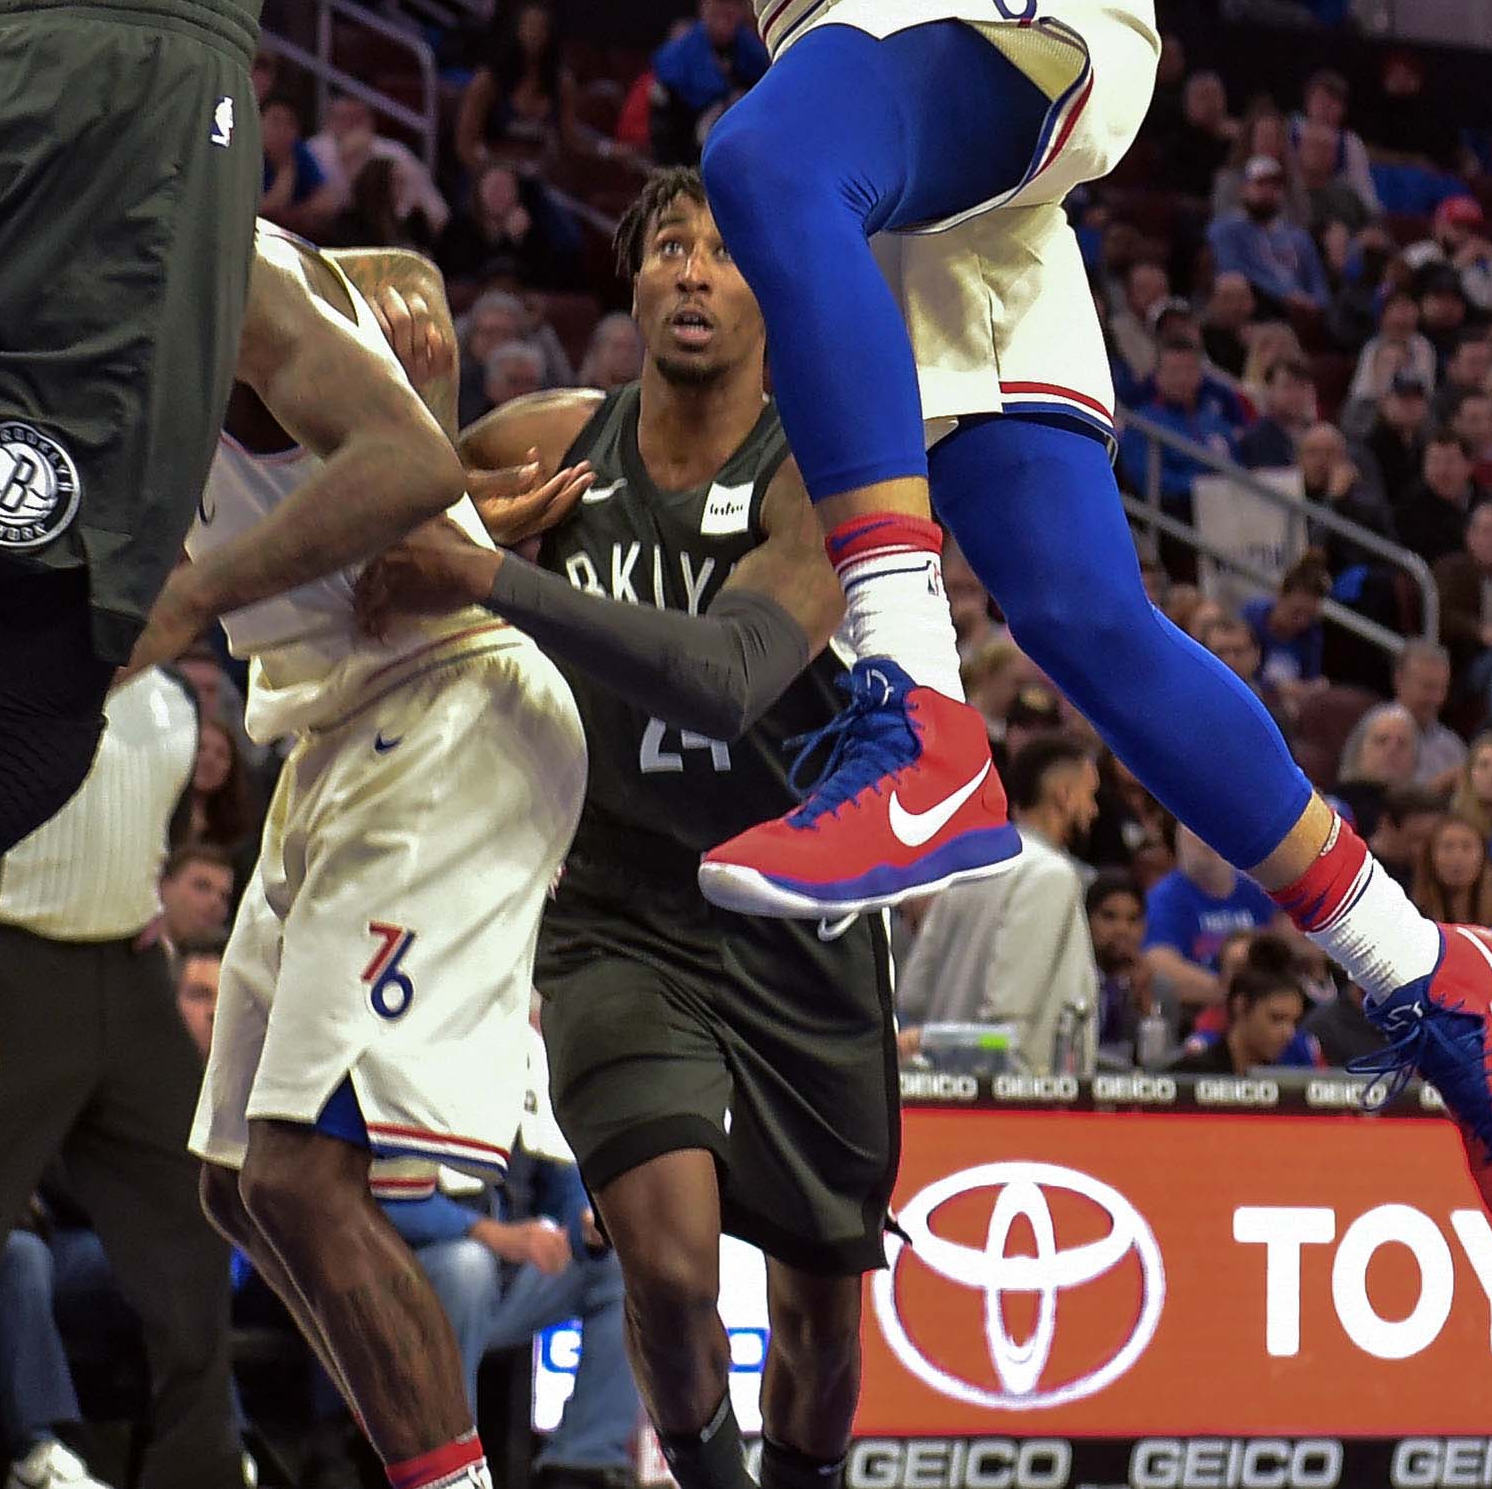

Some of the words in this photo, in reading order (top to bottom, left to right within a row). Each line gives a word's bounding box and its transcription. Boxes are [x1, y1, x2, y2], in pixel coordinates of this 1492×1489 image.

[362, 920, 416, 1020] 76
[847, 1438, 1073, 1488] GEICO
[1128, 1438, 1343, 1487] GEICO
